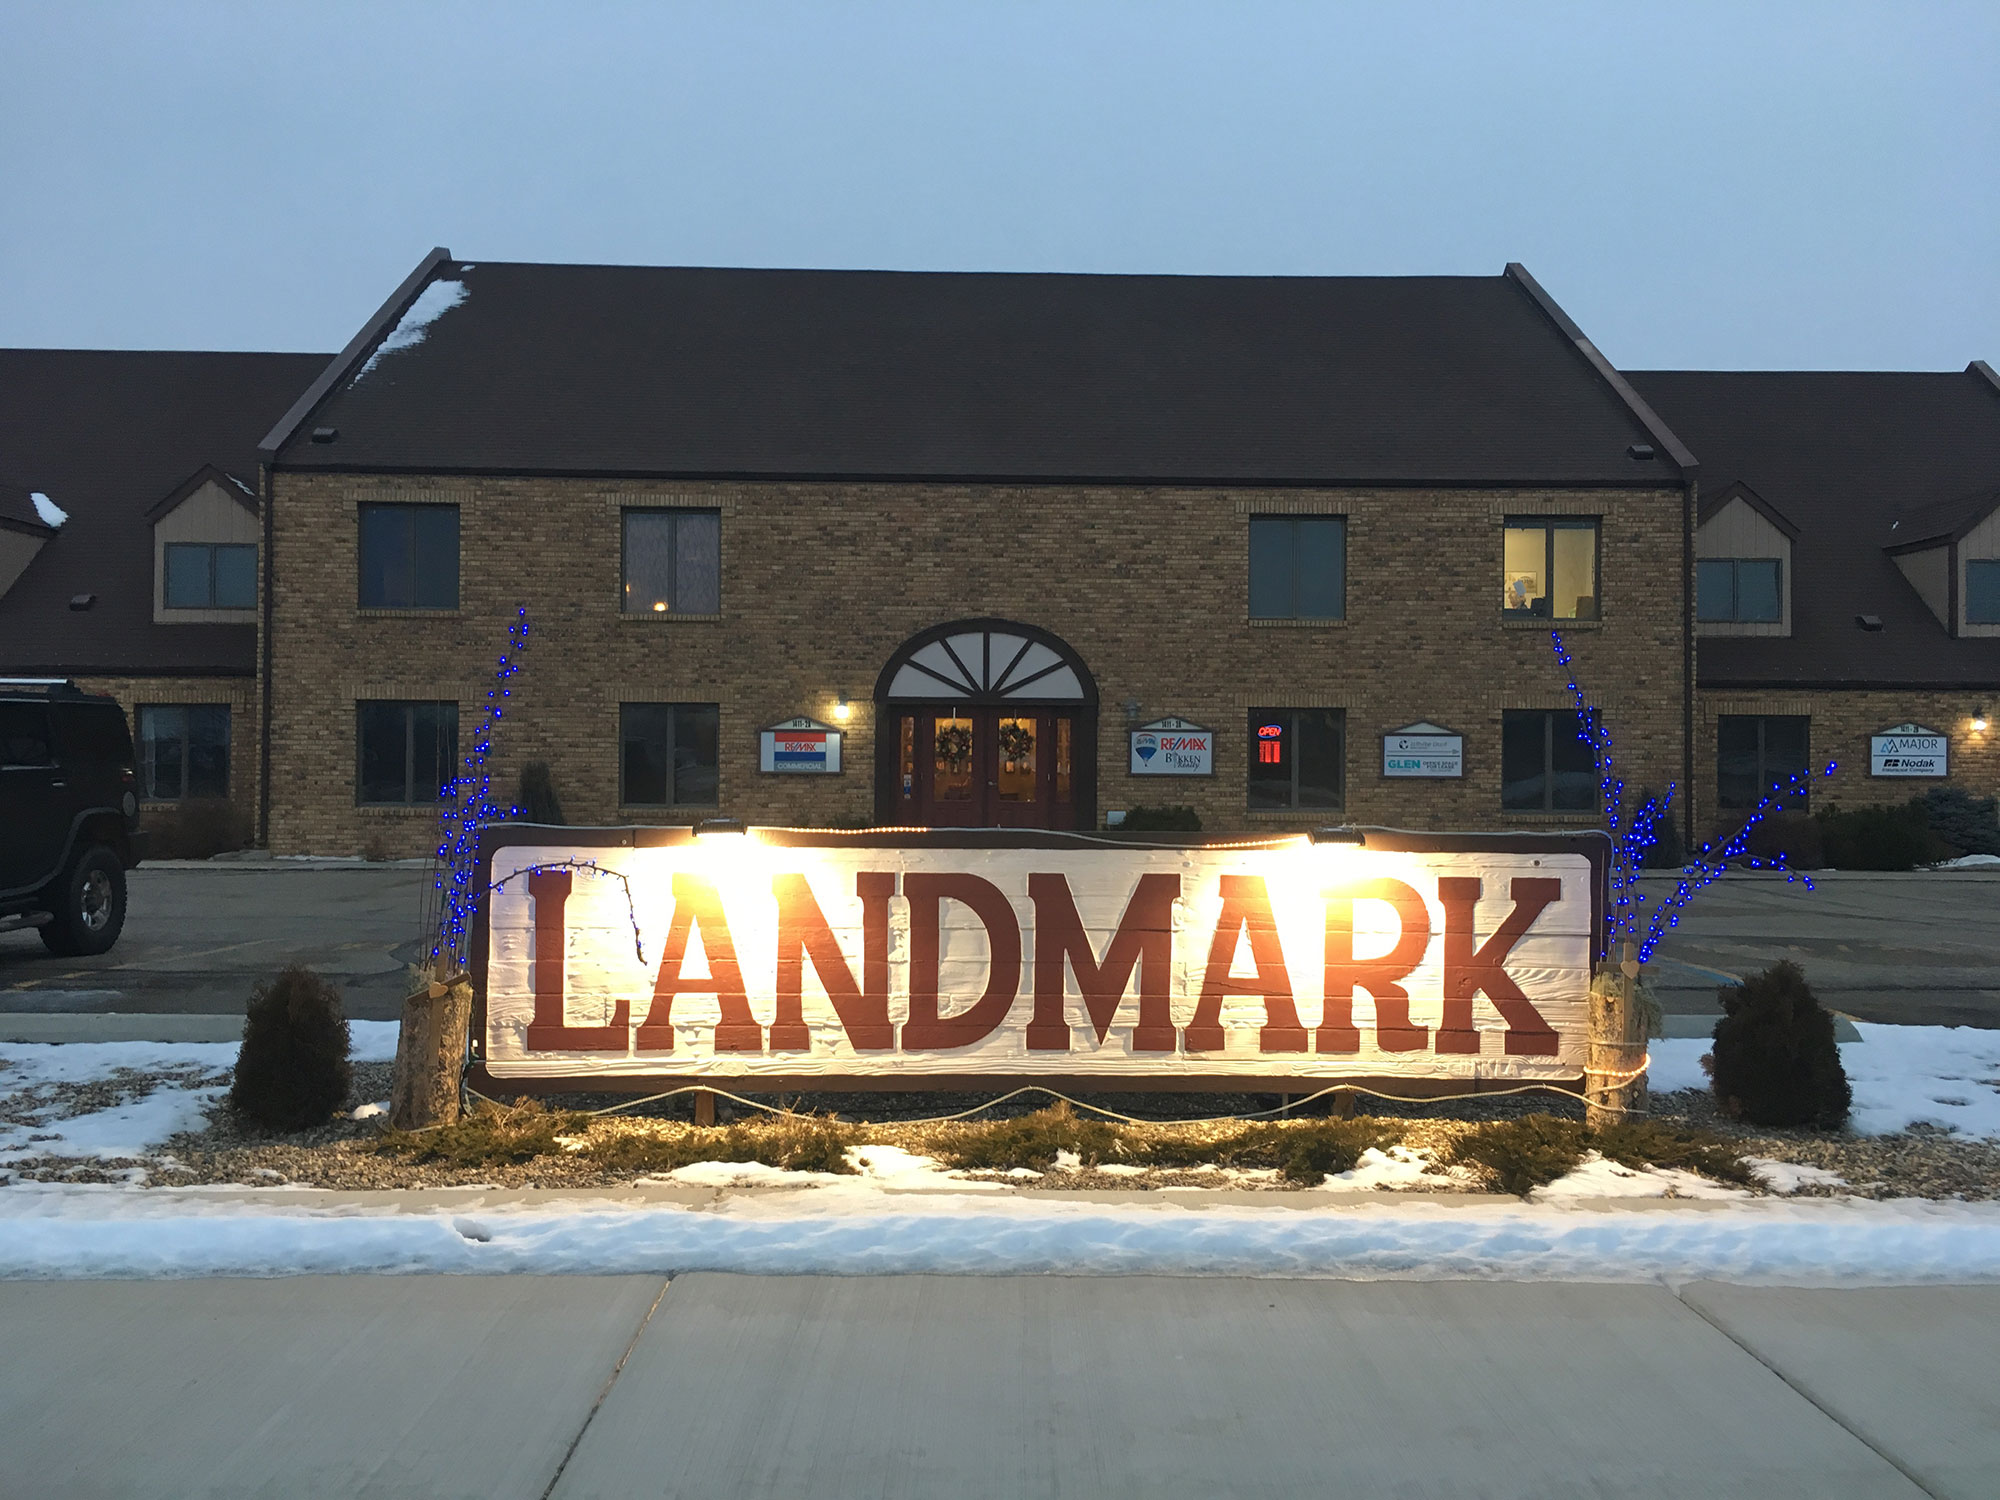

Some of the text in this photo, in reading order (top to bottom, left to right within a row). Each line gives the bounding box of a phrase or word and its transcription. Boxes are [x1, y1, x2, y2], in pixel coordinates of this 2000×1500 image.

[1258, 727, 1281, 736] OPEN
[785, 743, 816, 752] RE/MAX
[1161, 737, 1207, 751] RE/MAX
[1900, 739, 1938, 749] MAJOR
[1388, 760, 1420, 768] GLEN
[527, 870, 1561, 1056] LANDMARK
